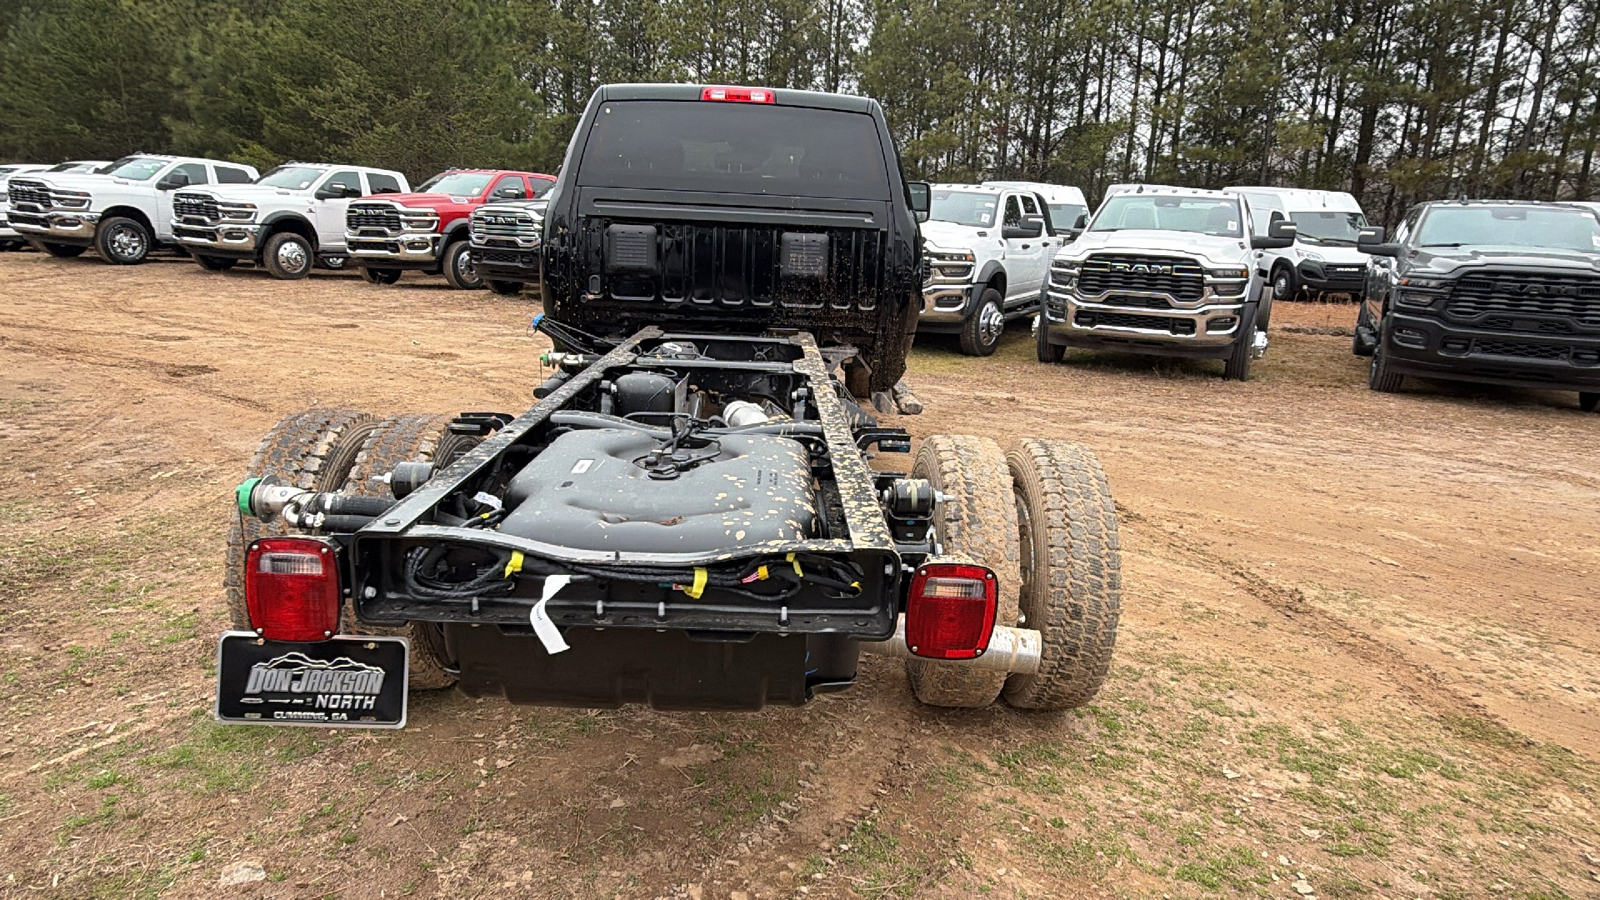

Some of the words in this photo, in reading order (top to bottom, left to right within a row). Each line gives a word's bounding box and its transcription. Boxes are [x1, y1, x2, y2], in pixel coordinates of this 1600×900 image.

[357, 208, 386, 216] RAM
[484, 216, 516, 224] RAM
[1110, 262, 1172, 274] RAM
[1493, 281, 1578, 295] RAM
[245, 667, 293, 694] DON
[291, 669, 386, 694] JACKSON
[315, 694, 376, 710] NORTH
[273, 710, 329, 721] CUMMING,
[331, 712, 348, 721] GA
